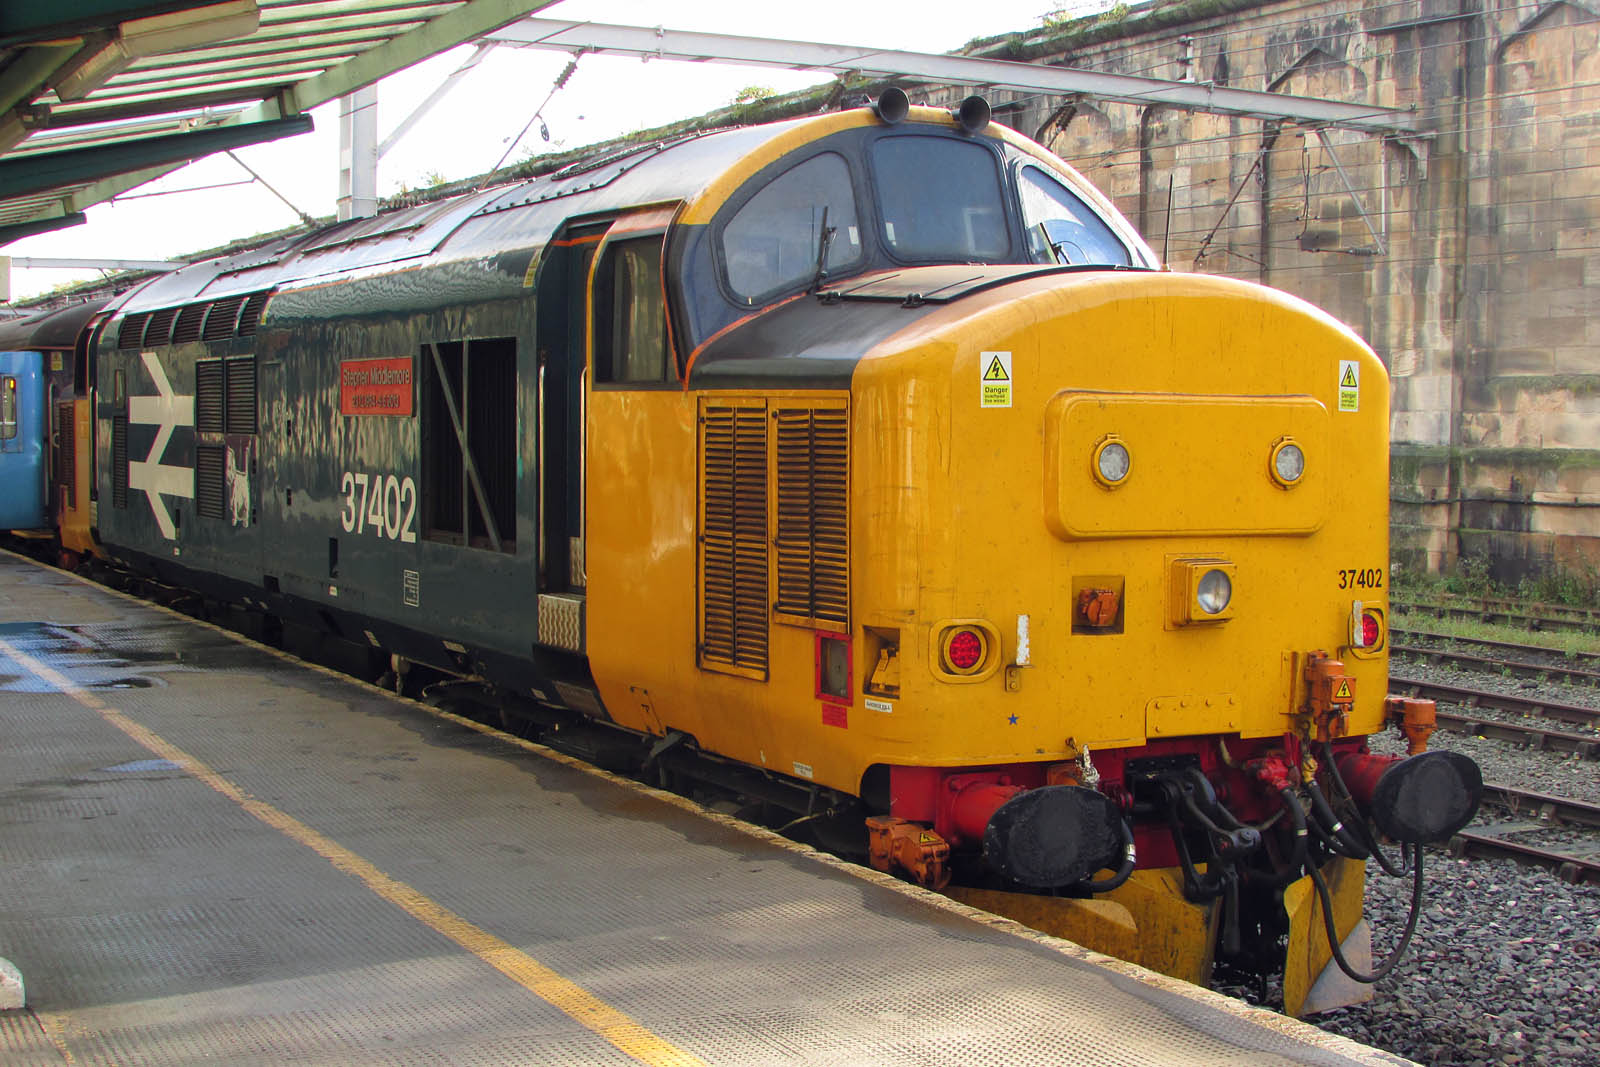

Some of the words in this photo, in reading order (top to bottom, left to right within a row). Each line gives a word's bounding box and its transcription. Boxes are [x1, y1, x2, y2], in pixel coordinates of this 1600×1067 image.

[343, 368, 369, 388] Stephen
[371, 367, 410, 385] Middlemore
[984, 386, 1008, 394] Danger
[341, 472, 416, 543] 37402
[1338, 568, 1383, 589] 37402
